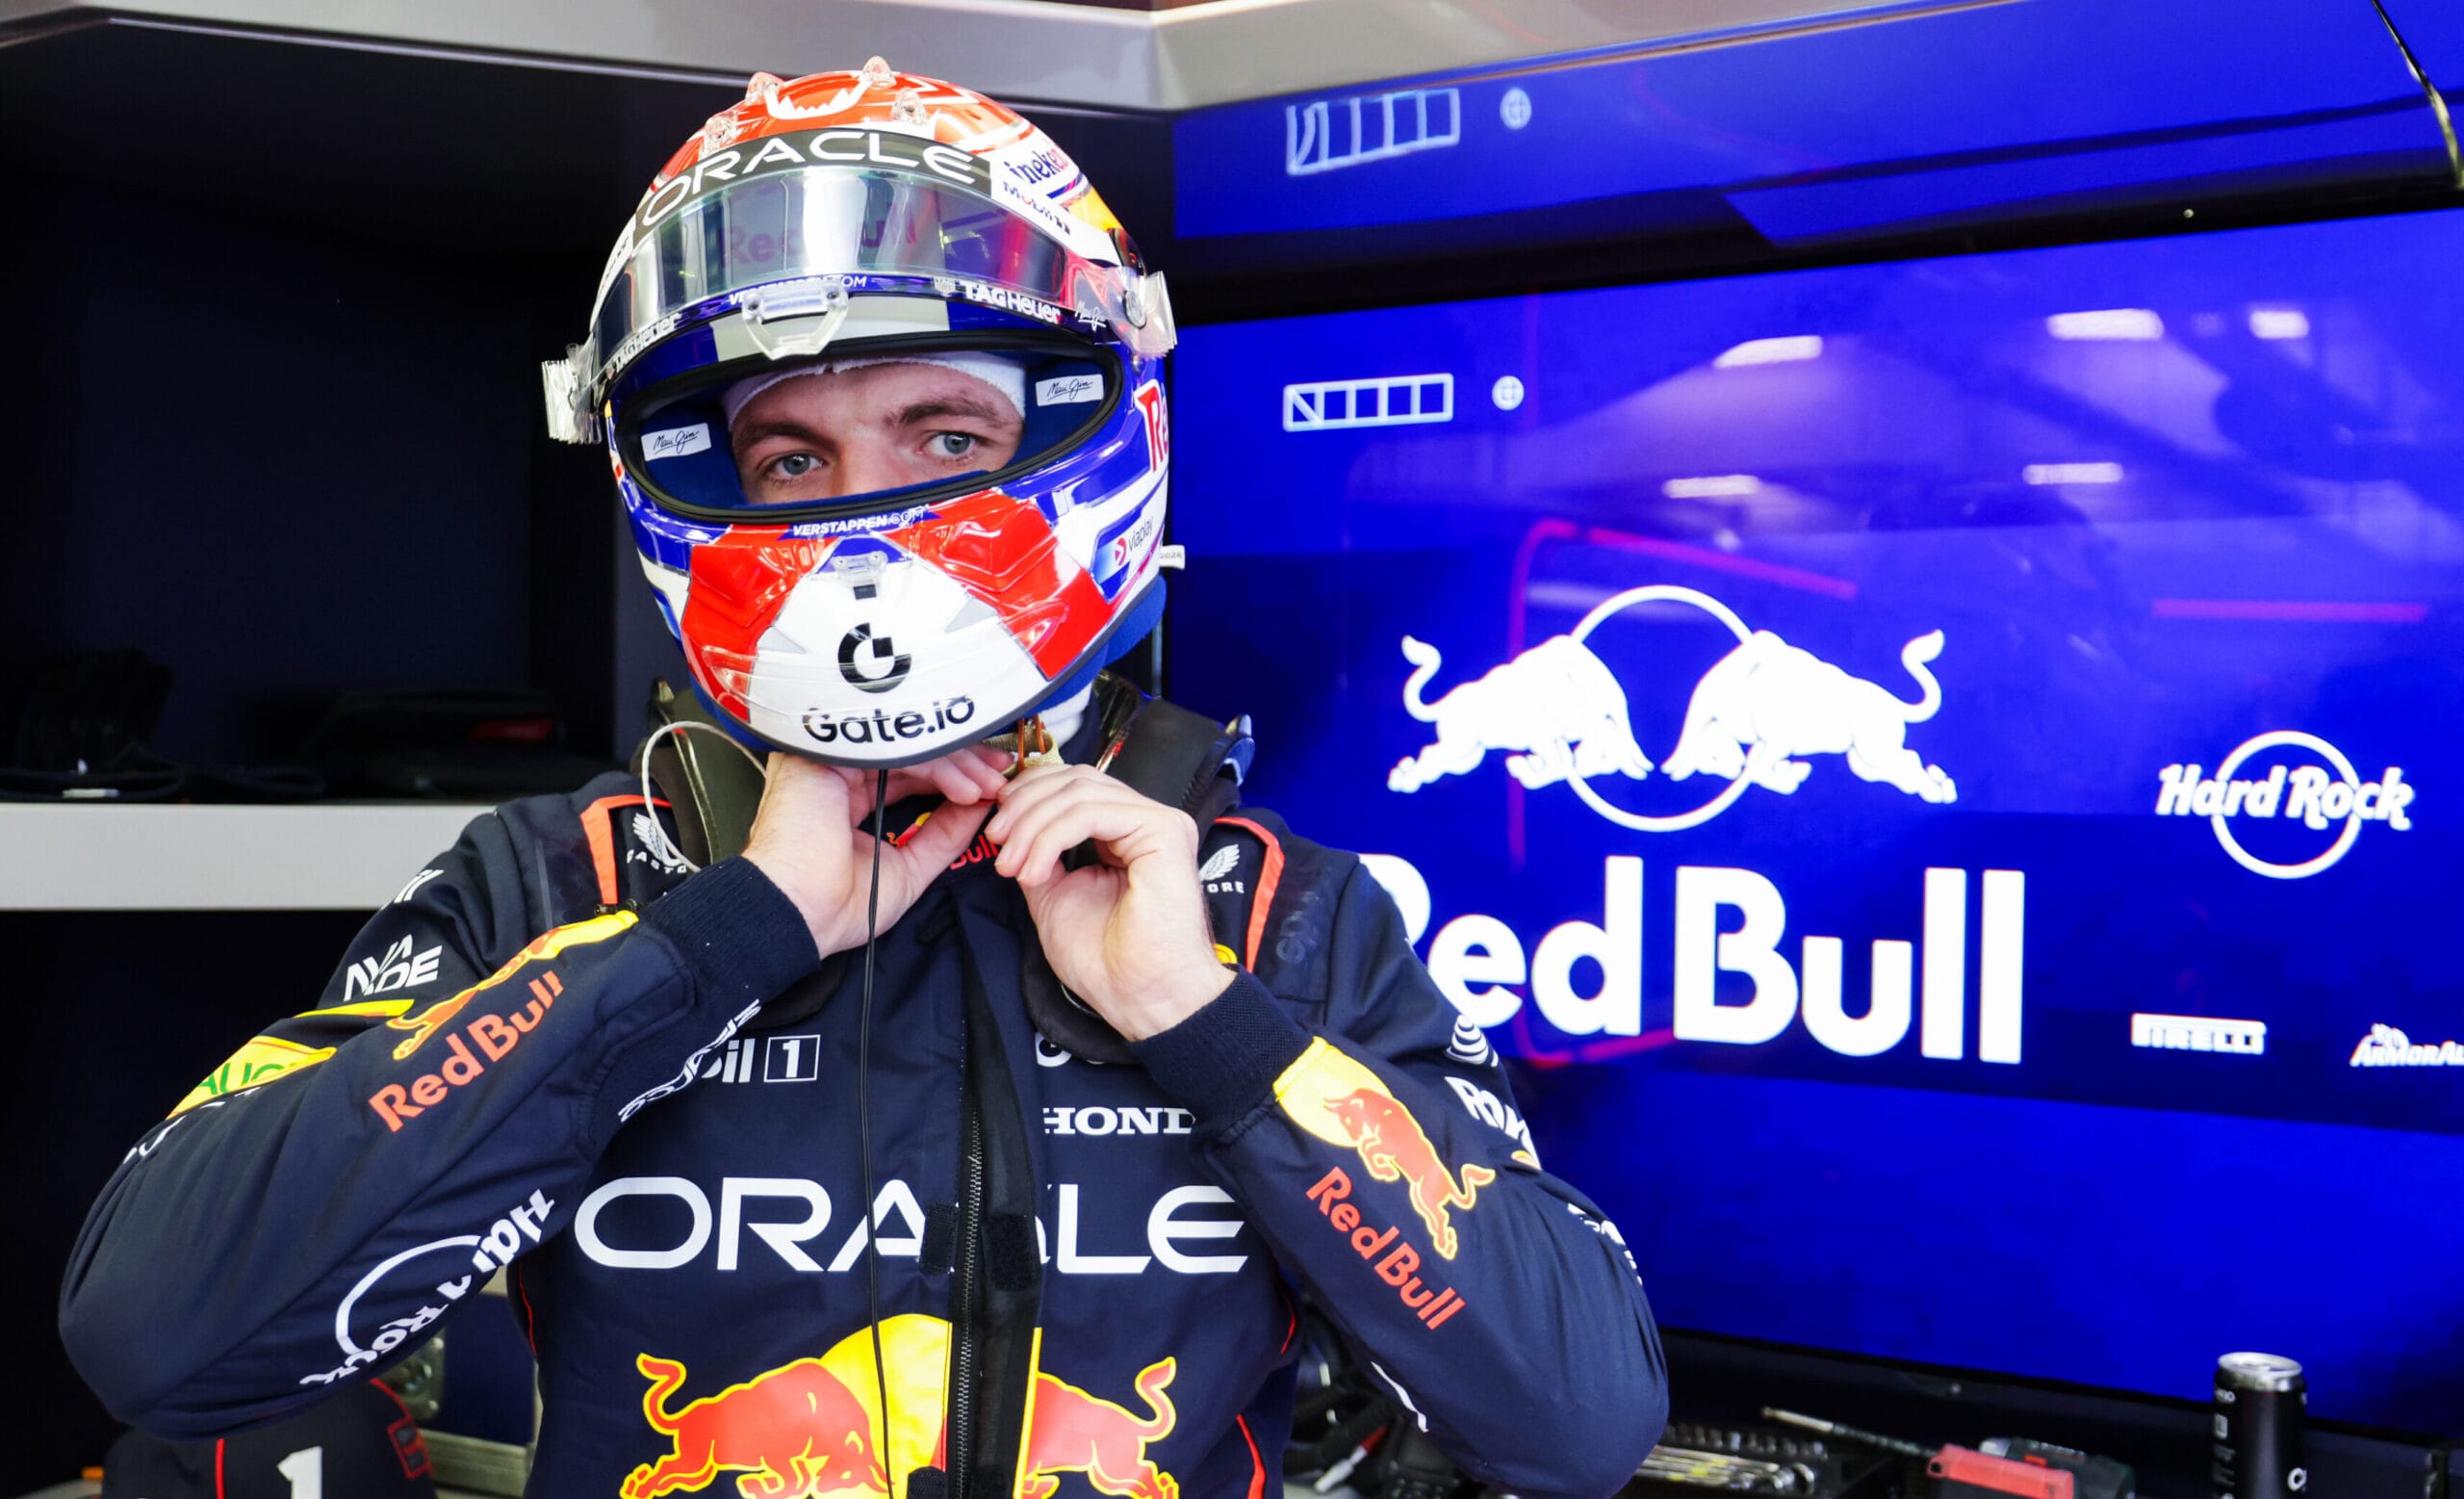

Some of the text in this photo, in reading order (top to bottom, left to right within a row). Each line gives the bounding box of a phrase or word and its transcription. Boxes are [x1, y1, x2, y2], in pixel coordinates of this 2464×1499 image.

[642, 132, 976, 226] ORACLE
[962, 281, 1007, 307] TAG
[1008, 291, 1062, 324] Heuer
[802, 695, 975, 744] Gate.io
[2155, 763, 2416, 831] Hard Rock
[1673, 865, 2025, 1065] Bull
[368, 1033, 485, 1133] Red
[466, 969, 564, 1063] Bull
[2130, 1012, 2267, 1055] PIRELLI
[1042, 1106, 1196, 1136] HOND
[574, 1176, 1249, 1274] ORALE
[1305, 1166, 1400, 1260] Red
[1373, 1242, 1467, 1331] Bull
